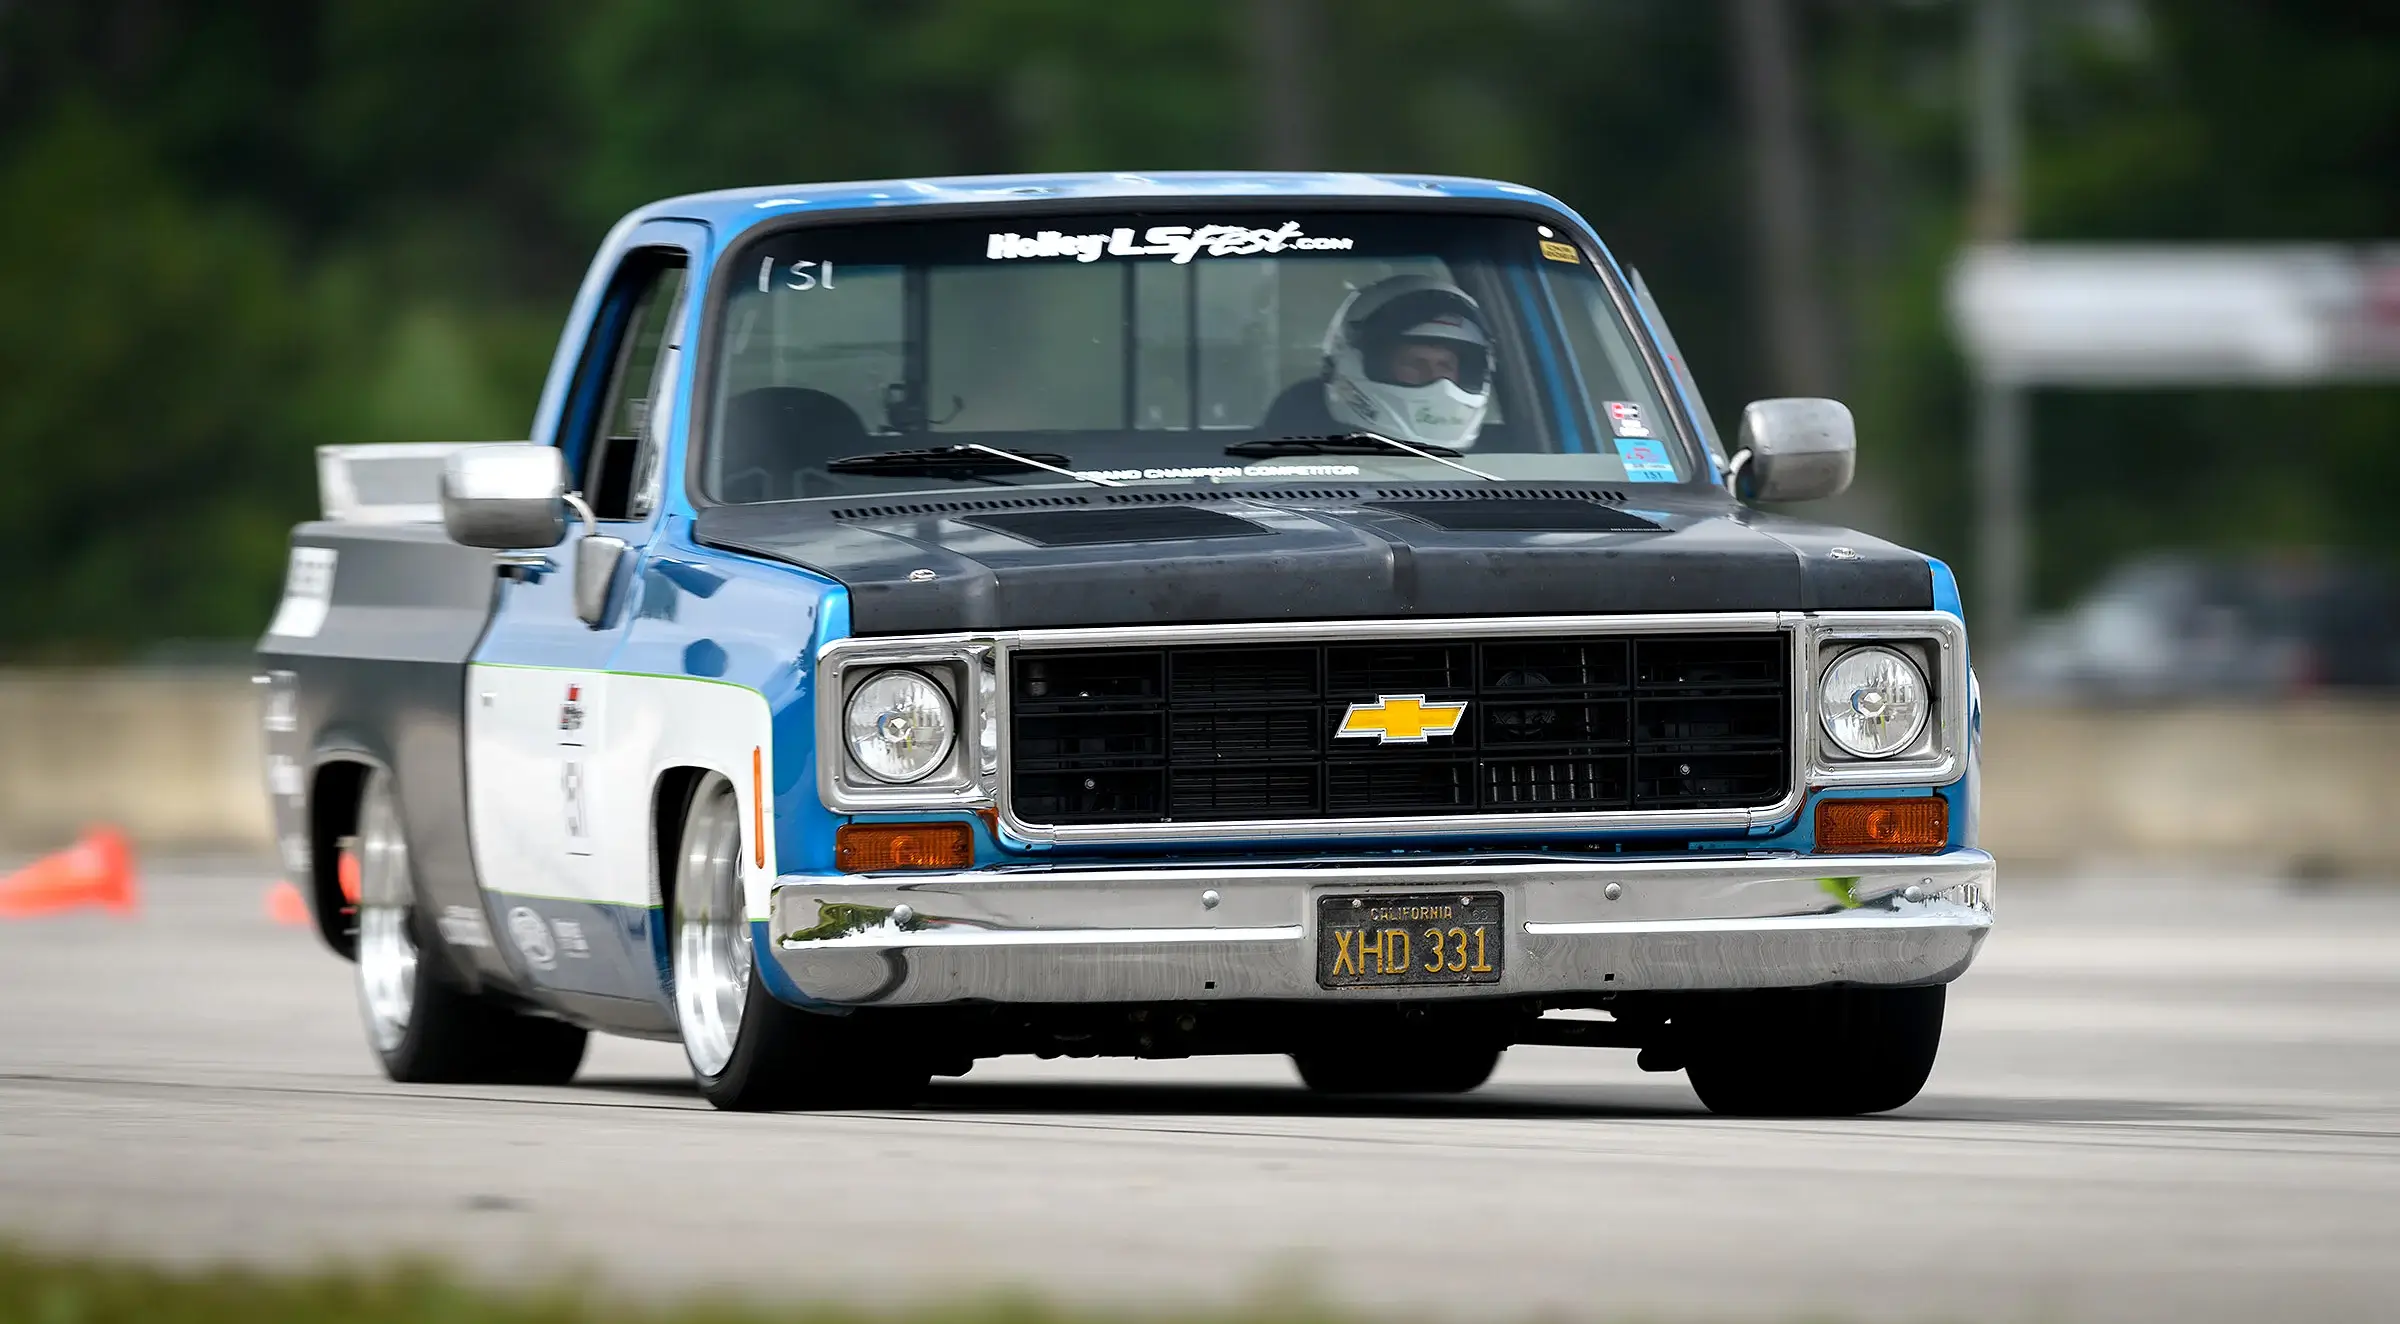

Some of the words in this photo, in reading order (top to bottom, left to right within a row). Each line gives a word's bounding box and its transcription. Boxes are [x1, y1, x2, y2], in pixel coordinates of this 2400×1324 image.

[1143, 467, 1242, 479] CHAMPION
[1244, 465, 1360, 477] COMPETITOR
[1370, 906, 1453, 921] CALIFORNIA
[1332, 927, 1411, 976] XHD
[1423, 926, 1493, 973] 331
